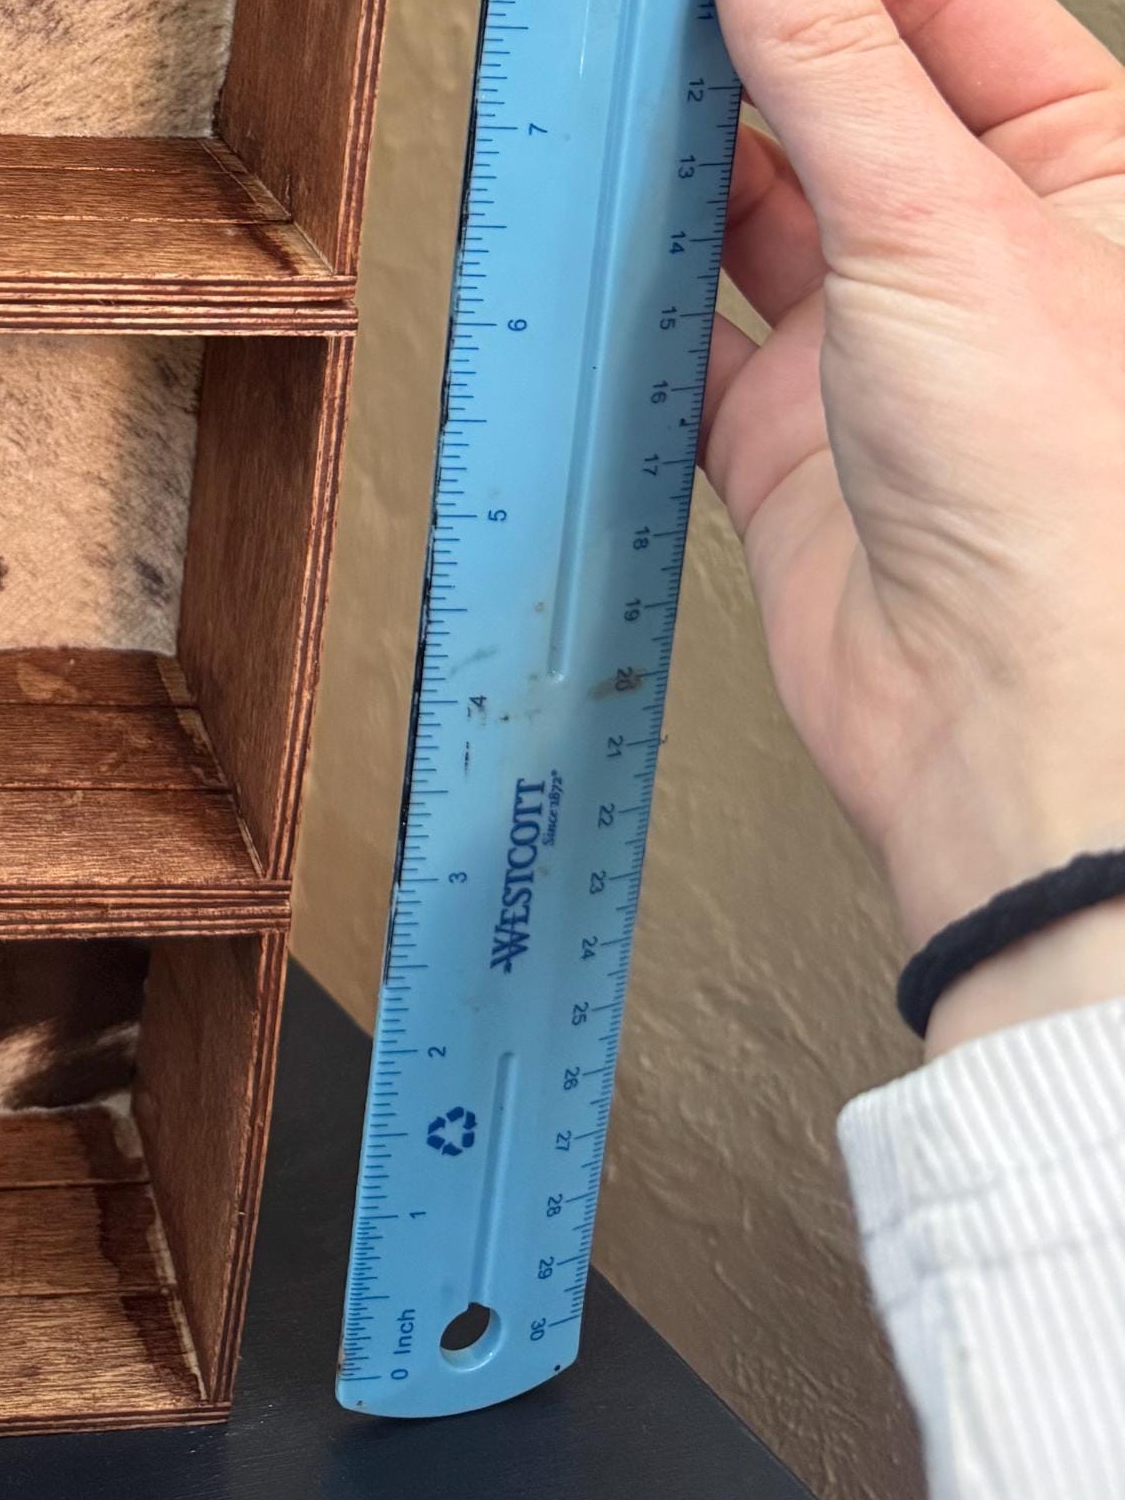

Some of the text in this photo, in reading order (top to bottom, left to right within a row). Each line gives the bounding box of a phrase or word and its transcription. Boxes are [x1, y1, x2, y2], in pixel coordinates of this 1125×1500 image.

[687, 77, 705, 103] 12
[529, 122, 548, 137] 7
[677, 155, 695, 178] 13
[668, 232, 686, 254] 14
[507, 318, 527, 333] 6
[659, 306, 676, 330] 15
[650, 380, 668, 404] 16
[642, 455, 659, 477] 17
[488, 509, 507, 523] 5
[633, 526, 650, 550] 18
[623, 599, 641, 622] 19
[469, 695, 487, 708] 4
[607, 736, 624, 759] 21
[599, 804, 616, 829] 22
[542, 811, 559, 847] Since
[449, 871, 467, 884] 3
[490, 778, 545, 975] WESTCOTT
[590, 871, 607, 896] 23
[580, 936, 599, 961] 24
[572, 1002, 589, 1027] 25
[428, 1045, 447, 1057] 2
[562, 1067, 580, 1091] 26
[555, 1131, 571, 1153] 27
[410, 1210, 426, 1220] 1
[546, 1194, 564, 1218] 28
[537, 1255, 555, 1280] 29
[394, 1308, 415, 1356] Inch
[530, 1317, 547, 1343] 30
